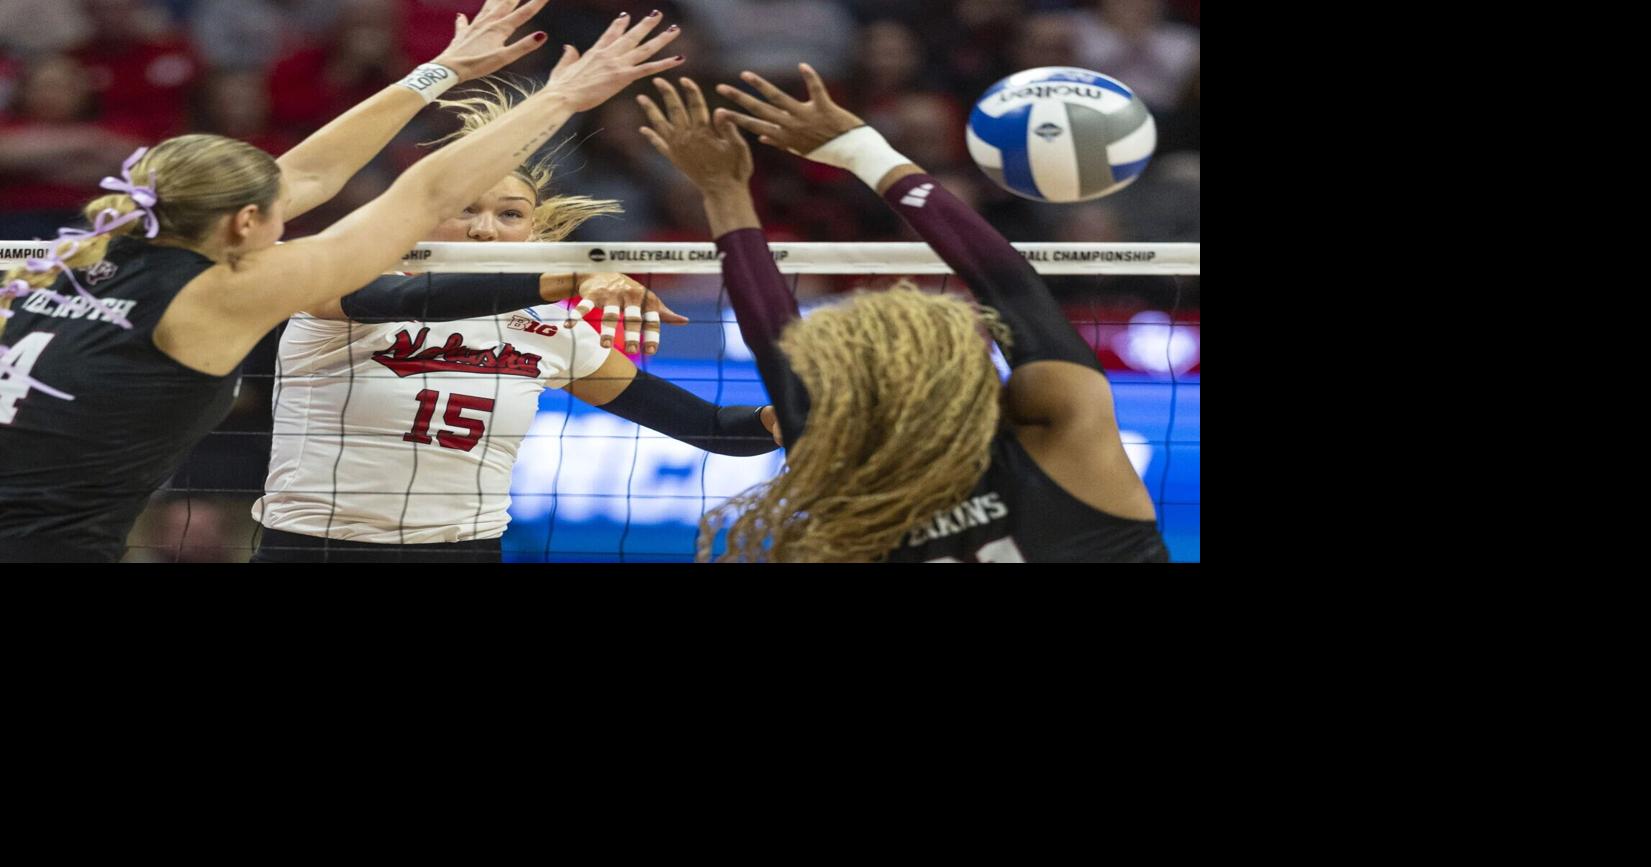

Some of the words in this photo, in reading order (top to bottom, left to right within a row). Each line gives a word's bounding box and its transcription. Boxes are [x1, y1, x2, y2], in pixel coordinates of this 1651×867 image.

[408, 67, 449, 91] LORD
[1000, 85, 1102, 102] molten
[0, 247, 49, 259] HAMPIO
[609, 250, 684, 261] VOLLEYBALL
[1053, 250, 1156, 262] CHAMPIONSHIP
[372, 328, 542, 377] Nebska
[402, 388, 496, 452] 15
